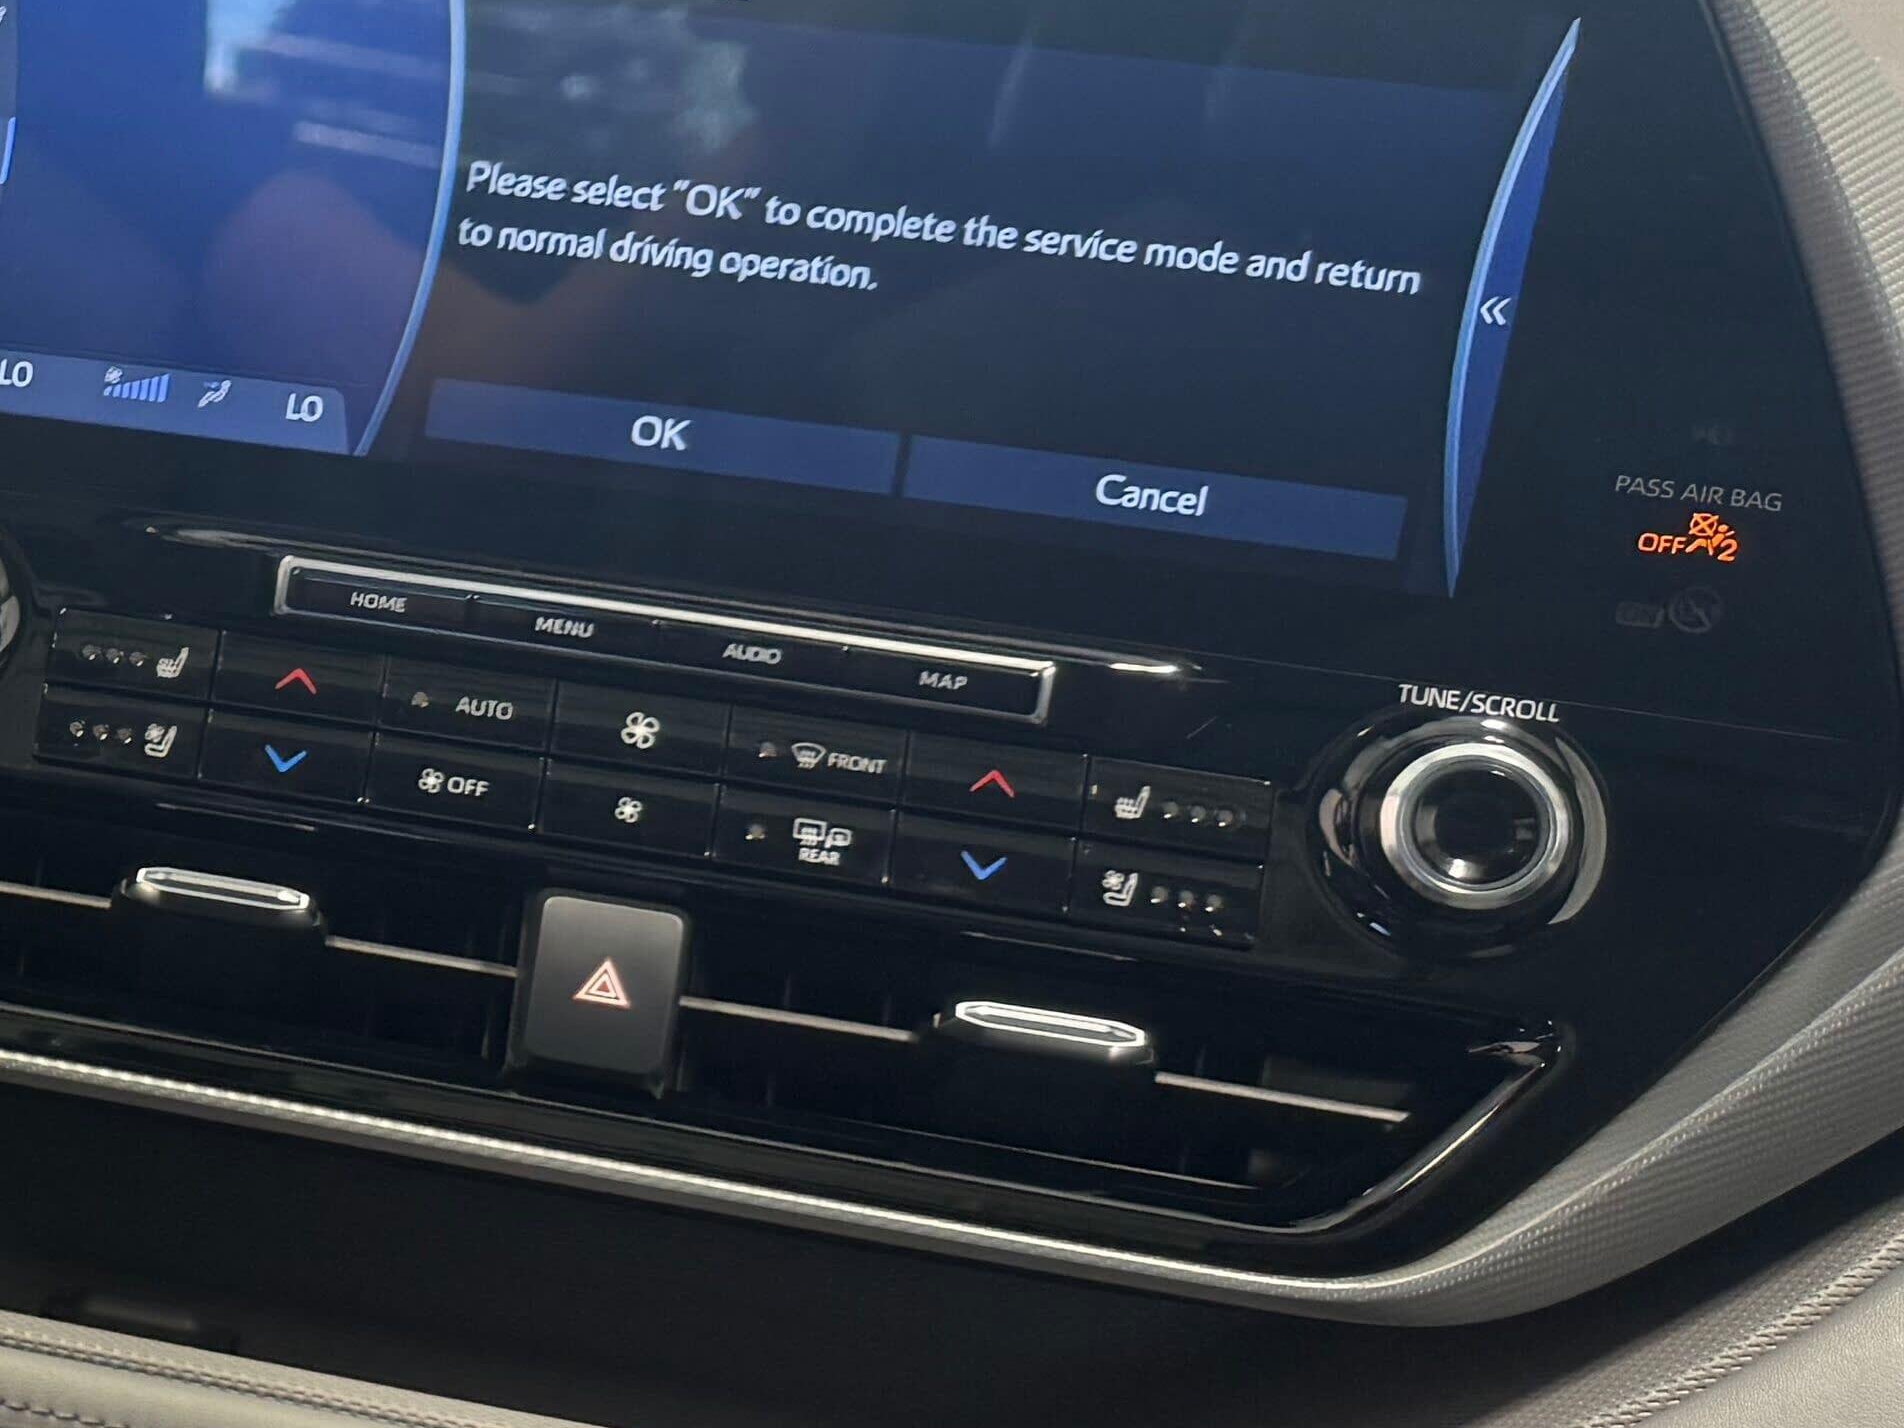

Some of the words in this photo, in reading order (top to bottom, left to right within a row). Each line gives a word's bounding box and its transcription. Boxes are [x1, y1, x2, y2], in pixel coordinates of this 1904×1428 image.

[465, 159, 567, 201] Please
[571, 174, 668, 212] select
[672, 179, 761, 221] "OK"
[764, 194, 802, 225] to
[805, 204, 957, 245] complete
[962, 214, 1018, 251] the
[1023, 229, 1138, 264] service
[1143, 240, 1240, 275] mode
[1245, 250, 1312, 283] and
[1314, 258, 1423, 296] return
[458, 216, 493, 247] to
[497, 224, 608, 260] normal
[610, 231, 714, 279] driving
[719, 252, 880, 291] operation.
[284, 391, 324, 423] LO
[630, 414, 692, 452] OK
[1094, 472, 1209, 518] Cancel
[1614, 475, 1675, 500] PASS
[1679, 483, 1724, 506] AIR
[1729, 488, 1783, 512] BAG
[1637, 532, 1687, 555] OFF
[1716, 537, 1739, 563] 2
[350, 590, 406, 614] HOME
[534, 616, 595, 639] MENU
[721, 642, 784, 665] AUDIO
[918, 670, 969, 691] MAP
[455, 695, 515, 721] AUTO
[1398, 683, 1561, 723] TUNE/SCROLL
[827, 750, 887, 776] FRONT
[446, 774, 491, 798] OFF
[798, 846, 841, 868] REAR
